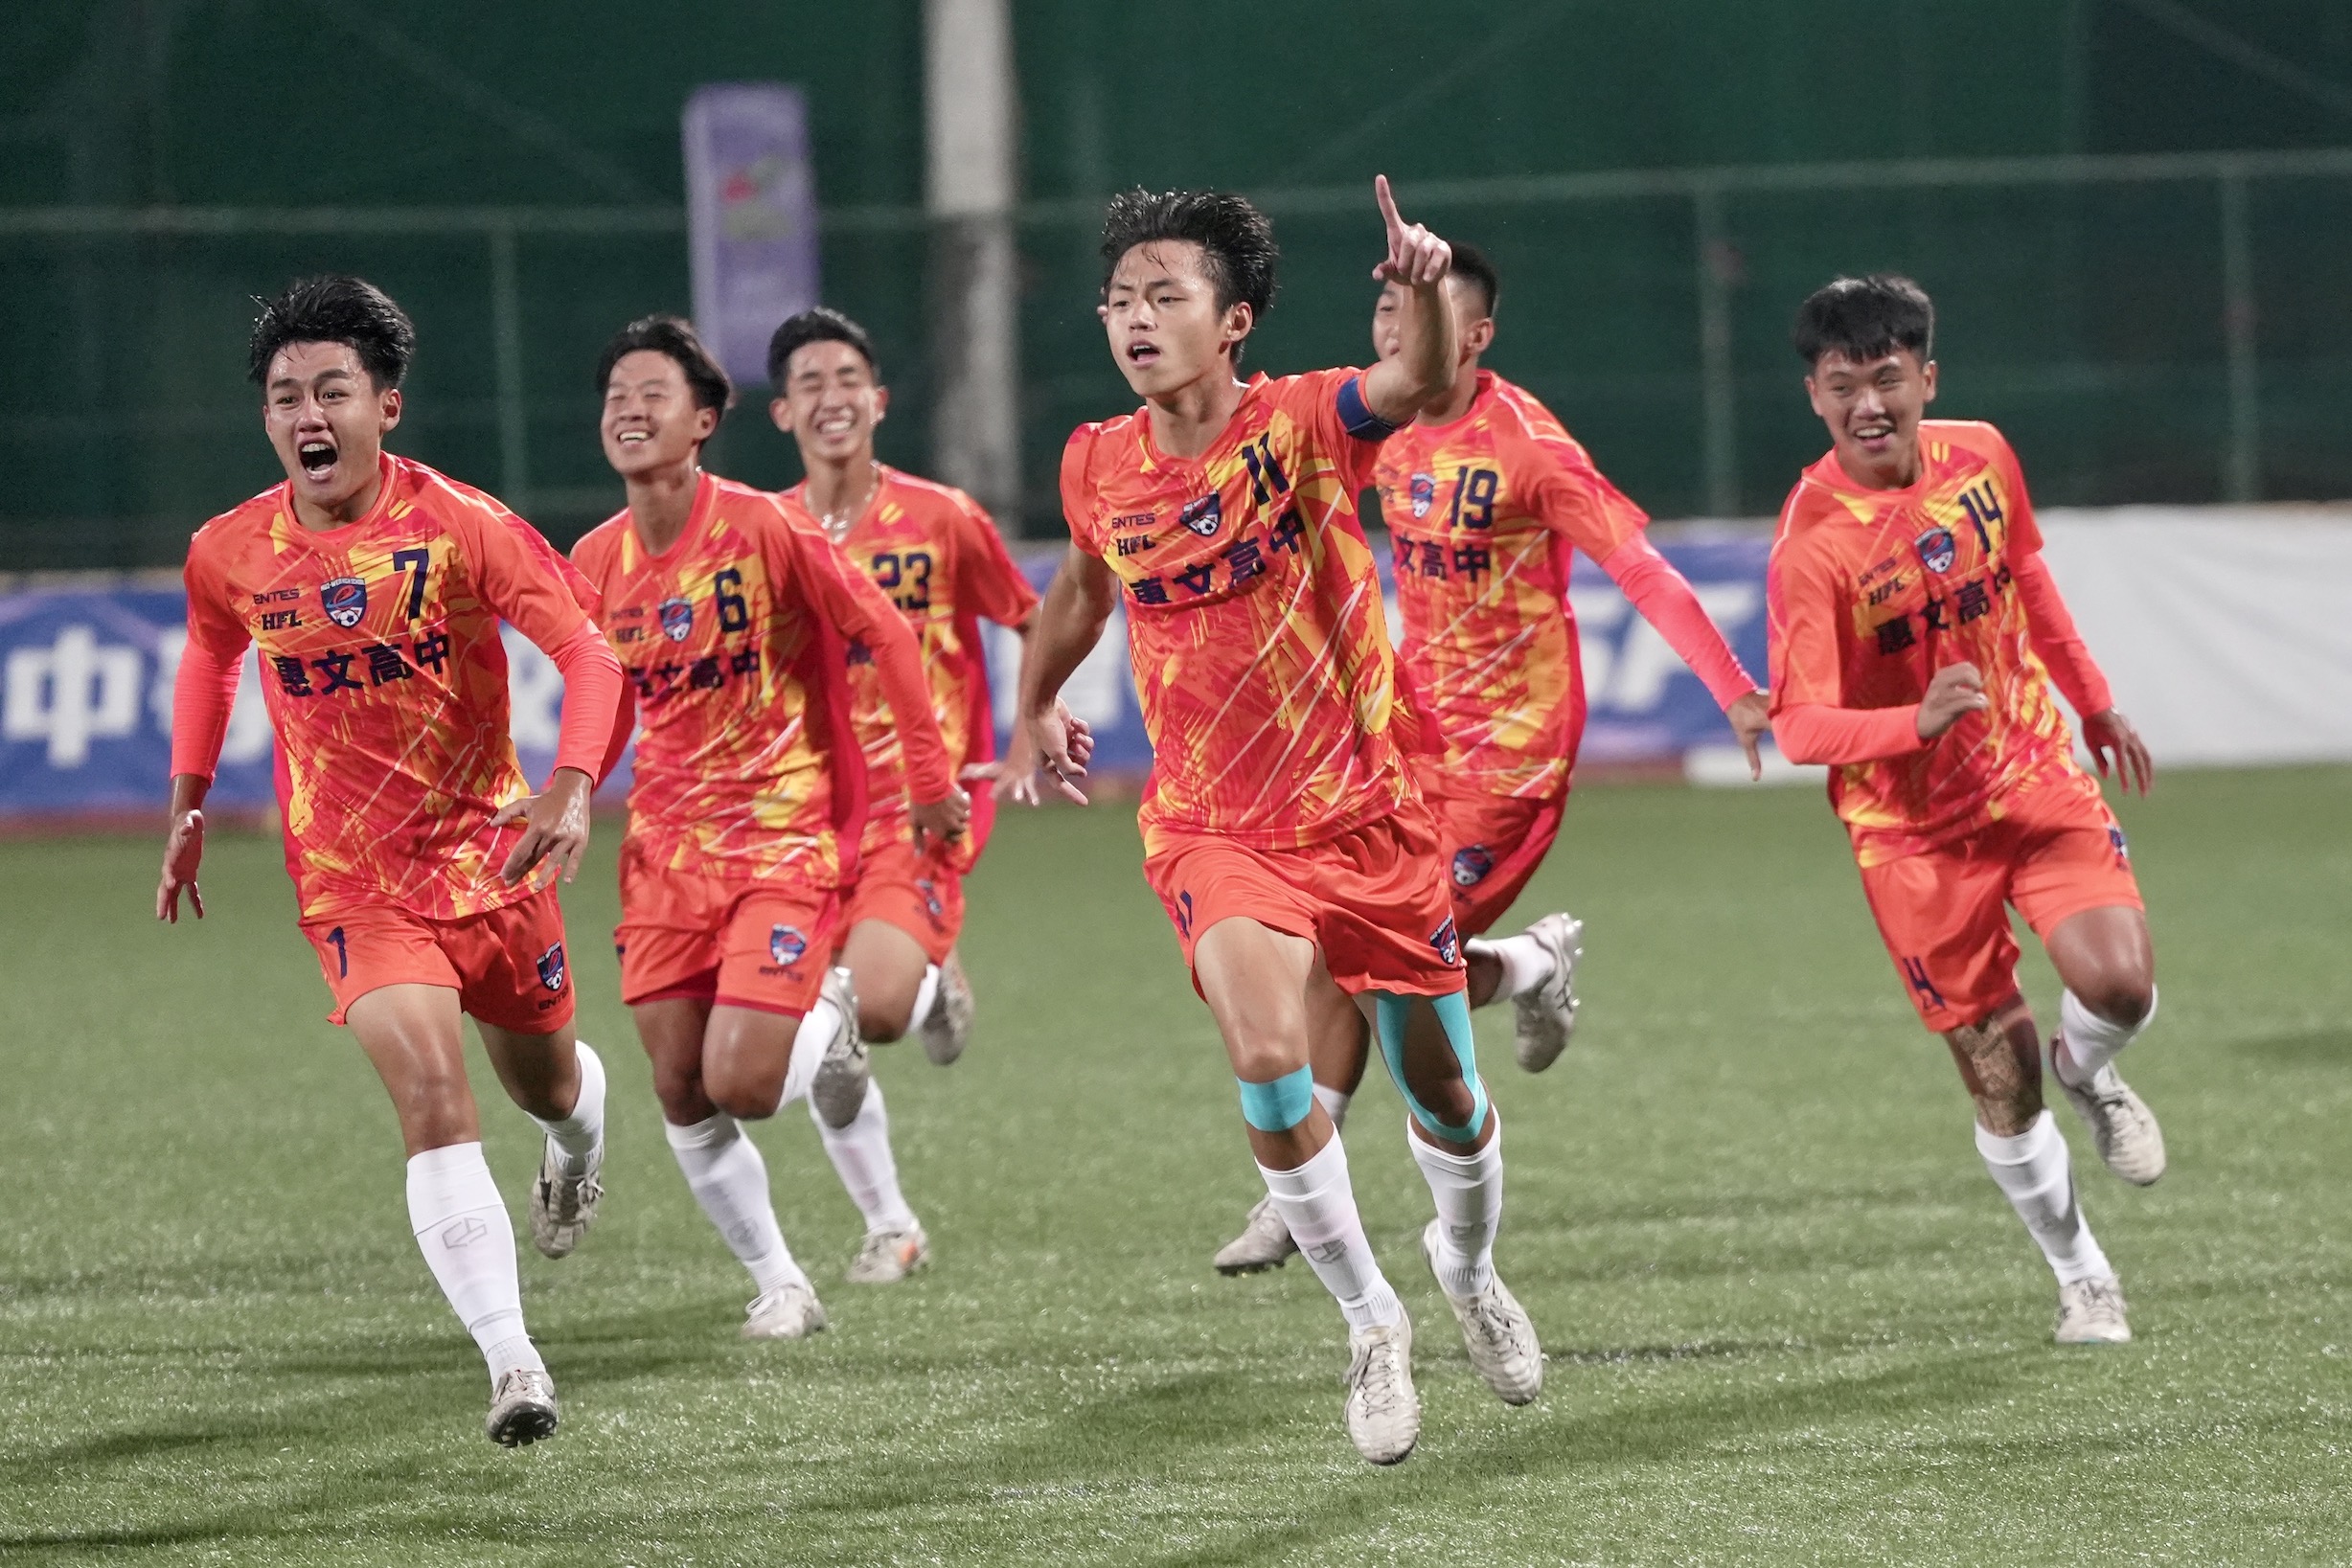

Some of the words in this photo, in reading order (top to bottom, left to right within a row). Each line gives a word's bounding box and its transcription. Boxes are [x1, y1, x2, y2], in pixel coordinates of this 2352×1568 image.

[1242, 431, 1290, 507] 11
[1450, 466, 1498, 530] 19
[1111, 513, 1154, 529] ENTES
[1116, 534, 1156, 557] HFL
[1959, 480, 2006, 555] 14
[392, 548, 429, 620] 7
[872, 552, 931, 610] 23
[1392, 532, 1492, 583] 文高中
[252, 588, 300, 605] ENTES
[261, 609, 302, 630] HFL
[714, 567, 748, 633] 6
[2, 625, 142, 766] 中
[272, 630, 449, 697] 惠文高中
